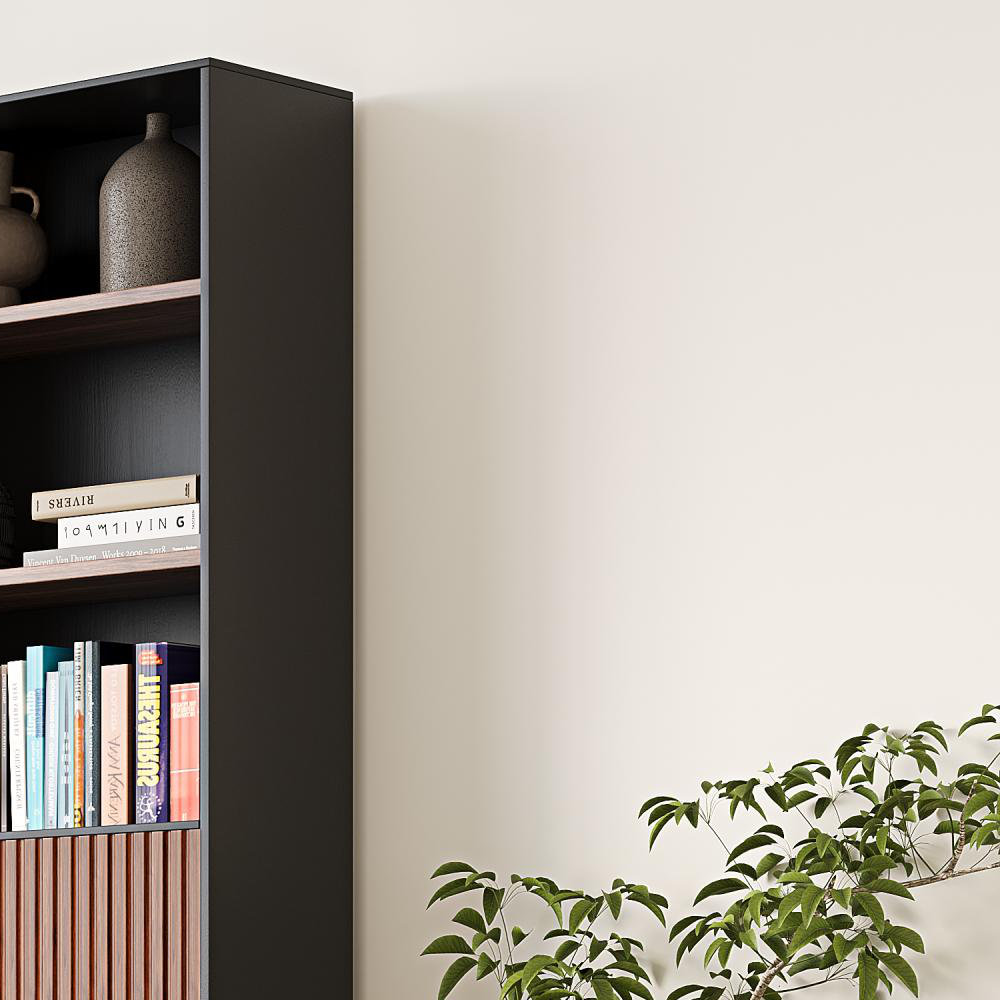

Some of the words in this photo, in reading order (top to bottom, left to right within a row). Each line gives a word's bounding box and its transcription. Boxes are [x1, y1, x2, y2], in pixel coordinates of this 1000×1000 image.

[48, 494, 95, 510] RIVERS
[55, 555, 69, 564] Van
[101, 550, 126, 559] Works
